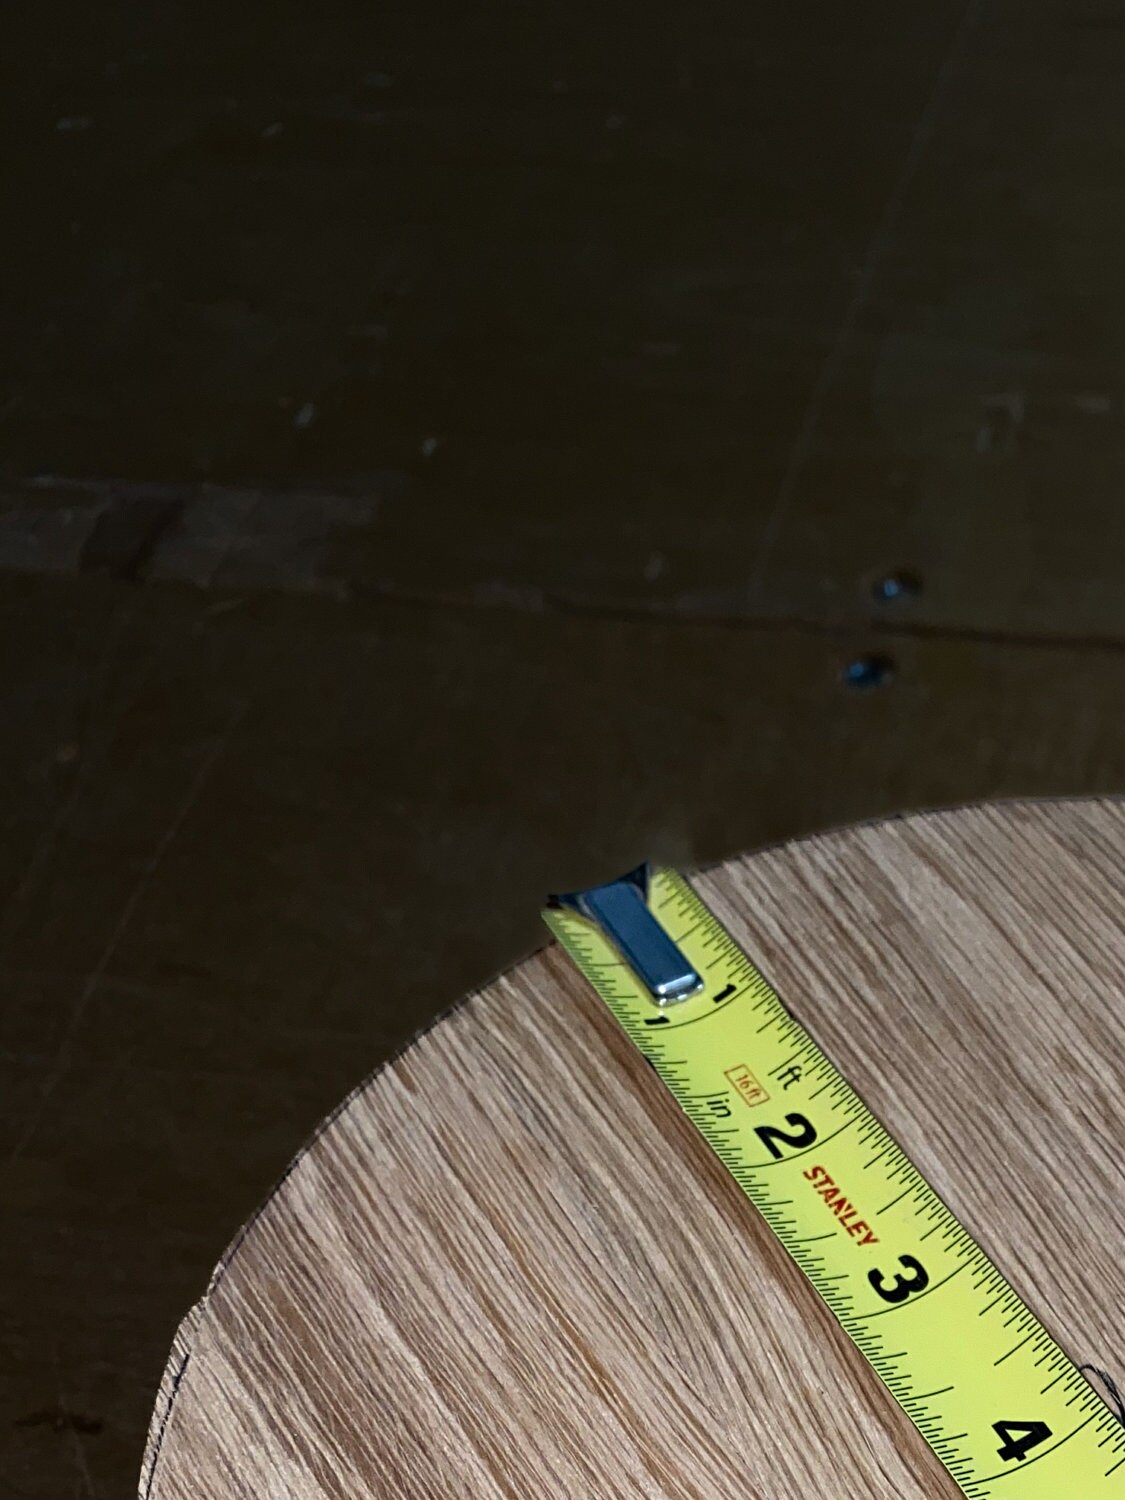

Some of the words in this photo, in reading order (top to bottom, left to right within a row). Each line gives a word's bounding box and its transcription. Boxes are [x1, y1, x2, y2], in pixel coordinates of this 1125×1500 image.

[711, 982, 737, 1004] 1
[643, 1015, 671, 1026] 1
[735, 1073, 754, 1090] 16
[745, 1087, 762, 1100] ft
[776, 1065, 803, 1091] ft
[706, 1098, 732, 1118] in
[753, 1112, 818, 1160] 2
[802, 1165, 880, 1247] STANLEY
[867, 1254, 930, 1304] 3
[991, 1419, 1054, 1462] 4
